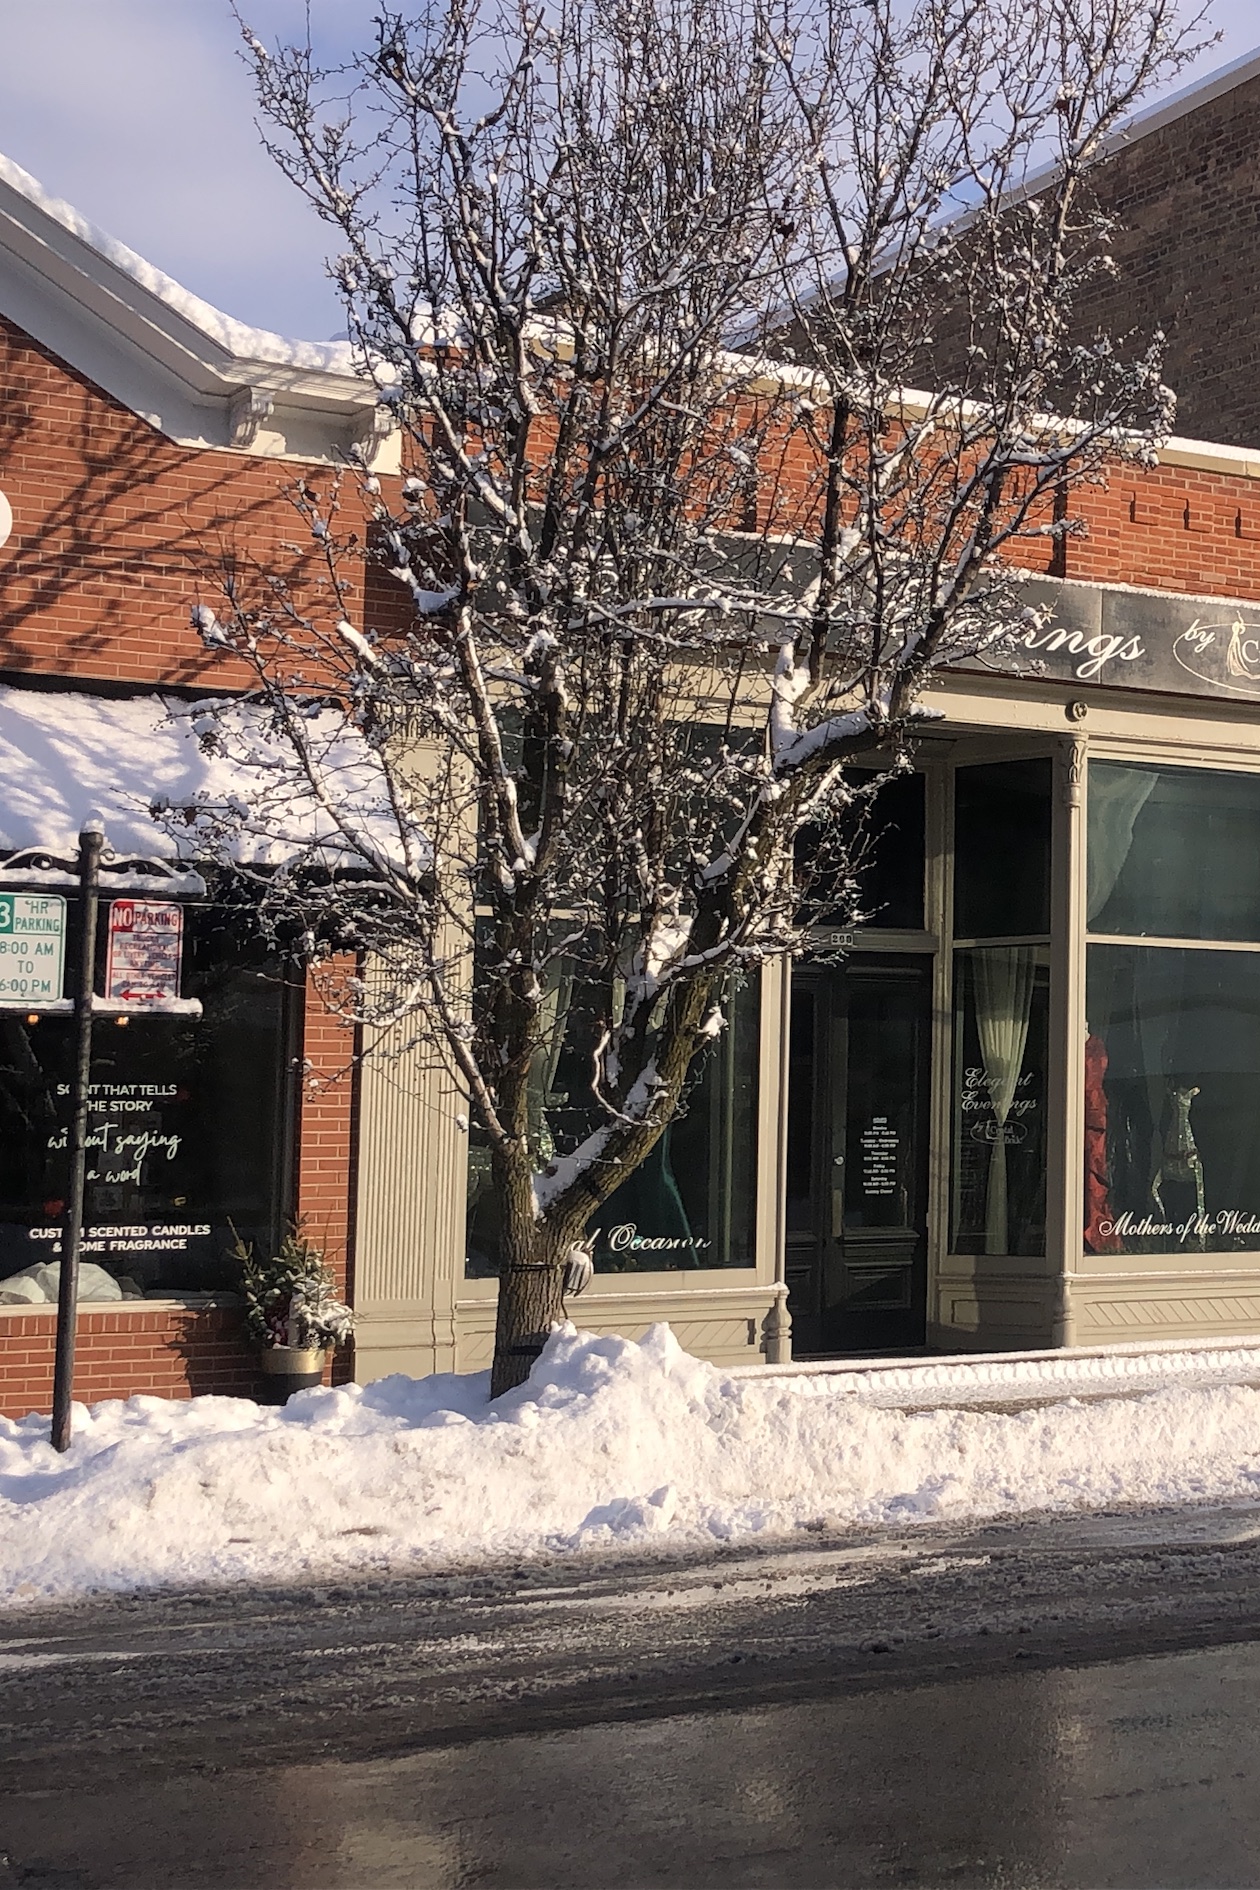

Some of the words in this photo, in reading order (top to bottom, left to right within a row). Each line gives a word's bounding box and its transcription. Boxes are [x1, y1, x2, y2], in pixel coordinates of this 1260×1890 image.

[1184, 618, 1216, 654] by
[0, 901, 11, 928] 3
[30, 901, 49, 914] HR
[113, 907, 132, 927] NO
[134, 912, 178, 927] PARKING
[15, 917, 60, 932] PARKING
[0, 941, 28, 955] 8:00
[34, 942, 54, 956] AM
[17, 960, 34, 974] TO
[0, 978, 28, 992] 6:00
[31, 979, 51, 993] PM
[102, 1084, 139, 1096] THAT
[140, 1084, 177, 1096] TELLS
[109, 1100, 153, 1112] STORY
[114, 1130, 182, 1161] saying
[87, 1169, 100, 1181] a
[105, 1160, 142, 1187] word
[88, 1226, 148, 1238] SCENTED
[152, 1225, 211, 1236] CANDLES
[1099, 1211, 1173, 1236] Mothers
[1175, 1212, 1197, 1243] of
[1194, 1213, 1217, 1235] the
[52, 1242, 62, 1253] &
[78, 1241, 106, 1252] OME
[110, 1239, 188, 1251] FRAGRANCE
